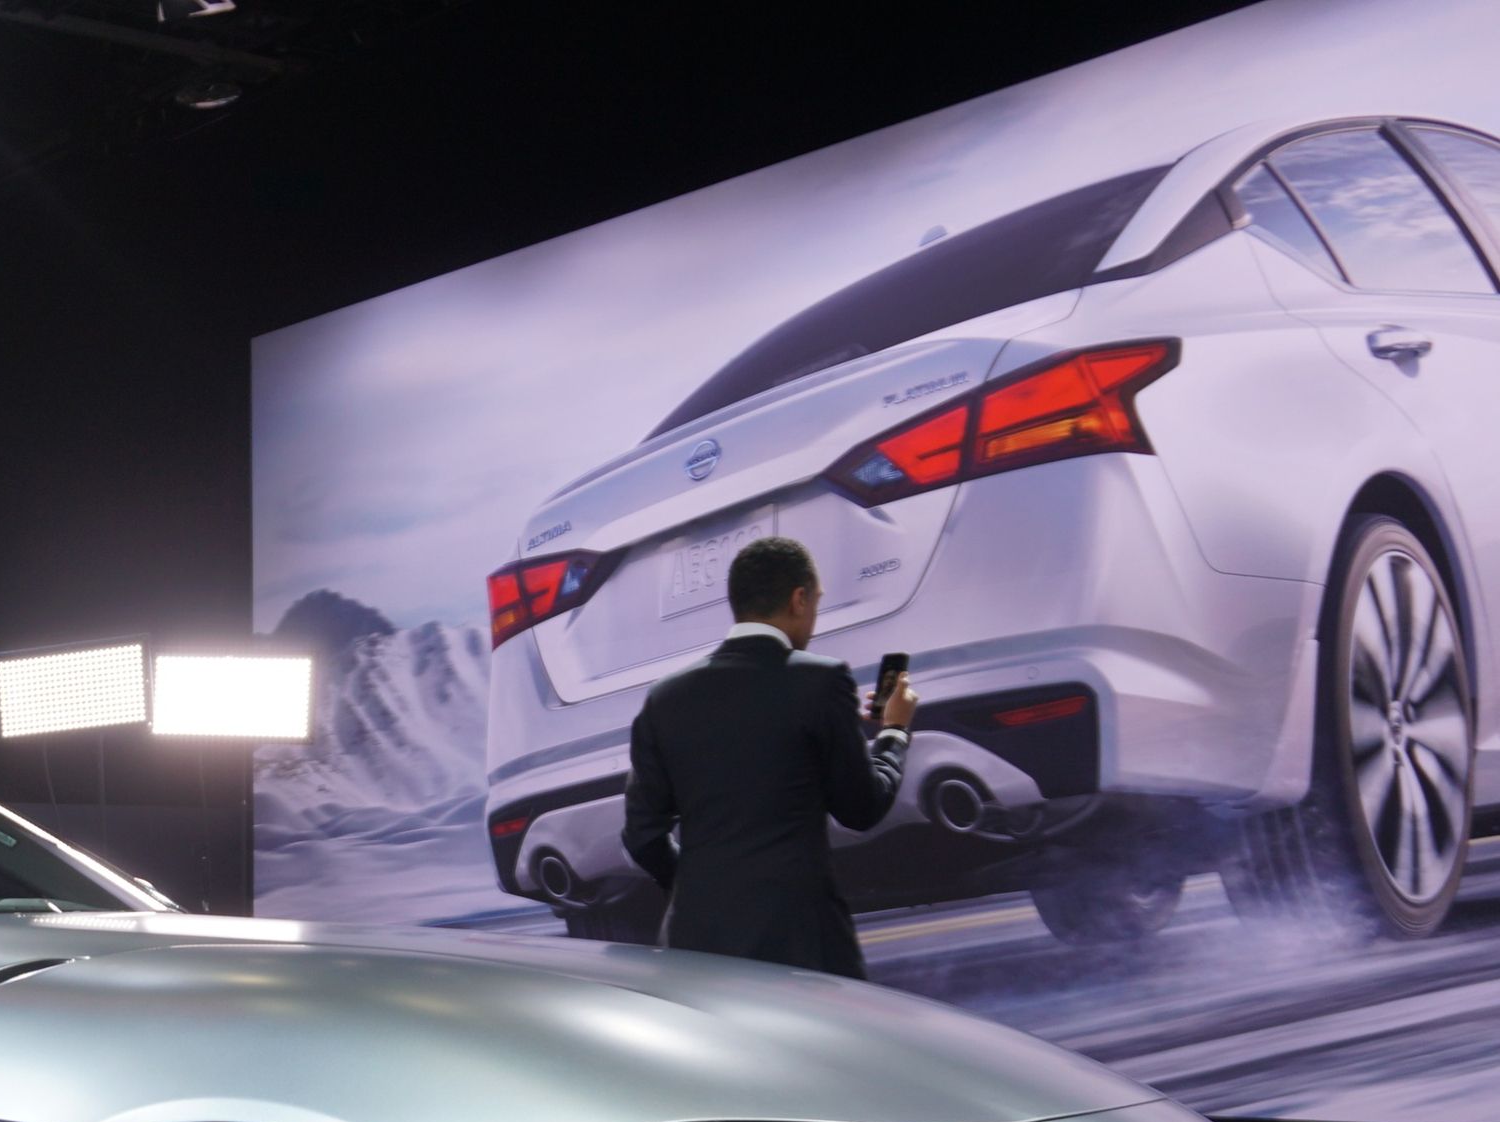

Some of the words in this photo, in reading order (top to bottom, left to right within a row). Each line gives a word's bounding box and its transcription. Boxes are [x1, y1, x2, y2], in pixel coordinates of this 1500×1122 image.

[882, 371, 969, 409] PLATINUM
[526, 520, 572, 551] ALTIMA
[856, 558, 901, 581] AWD
